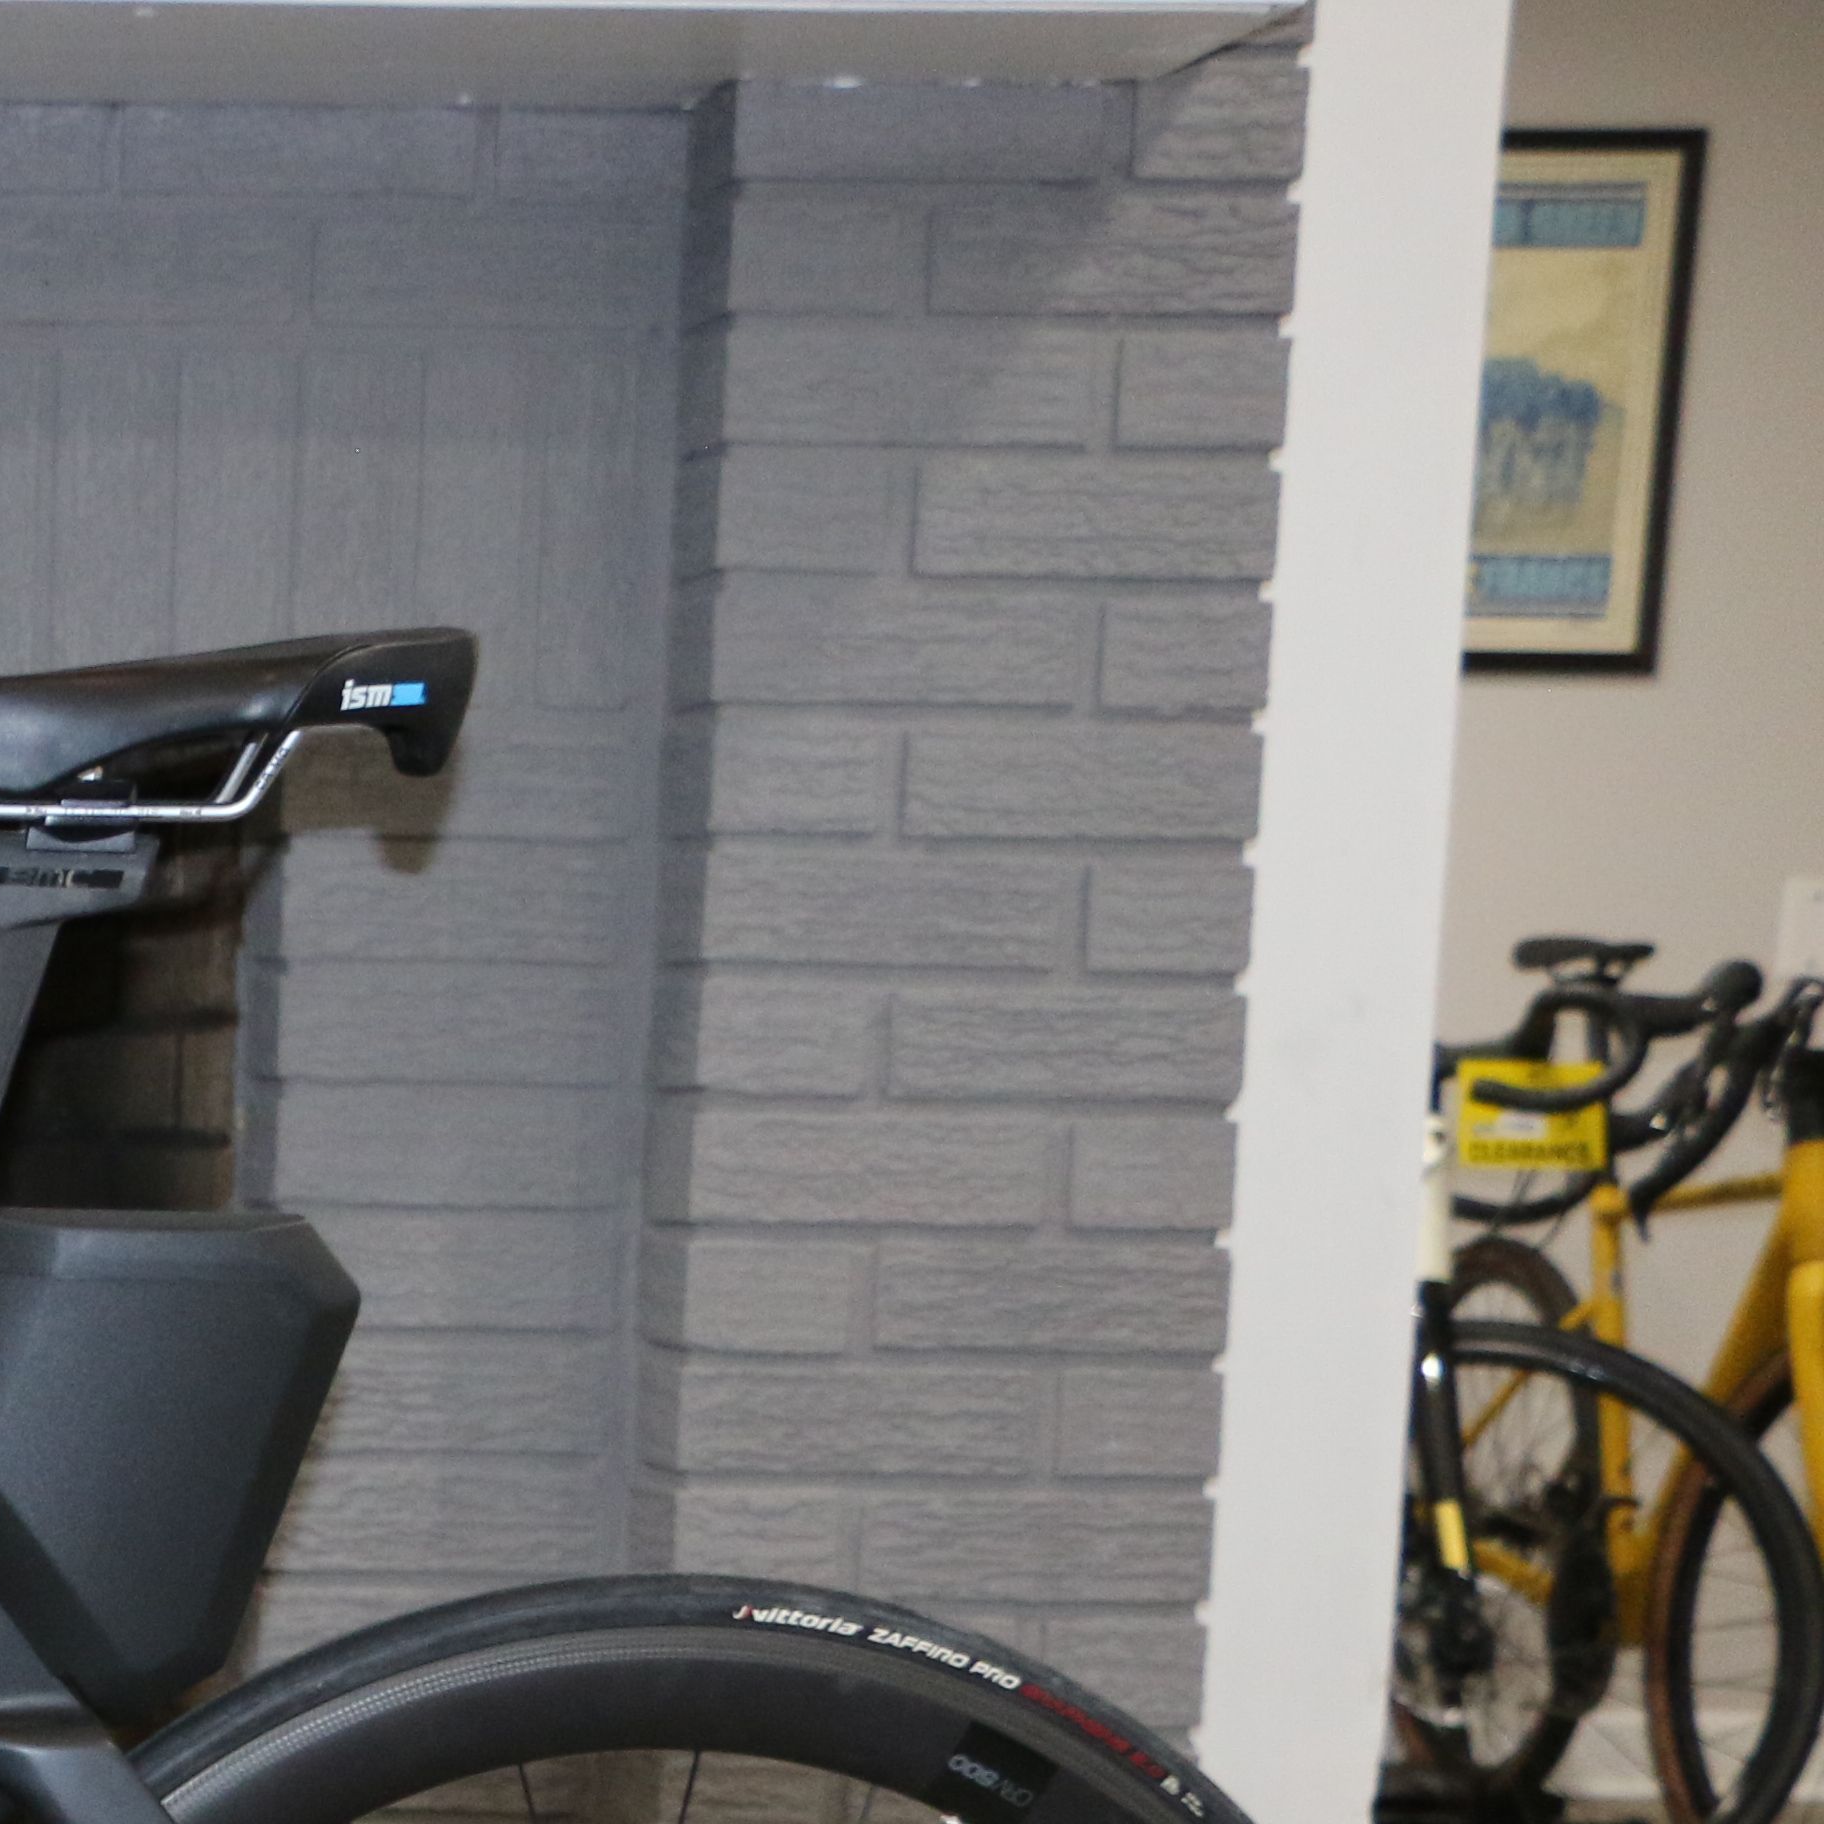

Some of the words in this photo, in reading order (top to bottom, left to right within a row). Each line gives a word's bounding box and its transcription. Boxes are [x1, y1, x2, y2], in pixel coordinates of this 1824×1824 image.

[752, 1607, 863, 1637] vittoria
[867, 1627, 970, 1668] ZAFFIRO
[969, 1660, 1022, 1690] PRO
